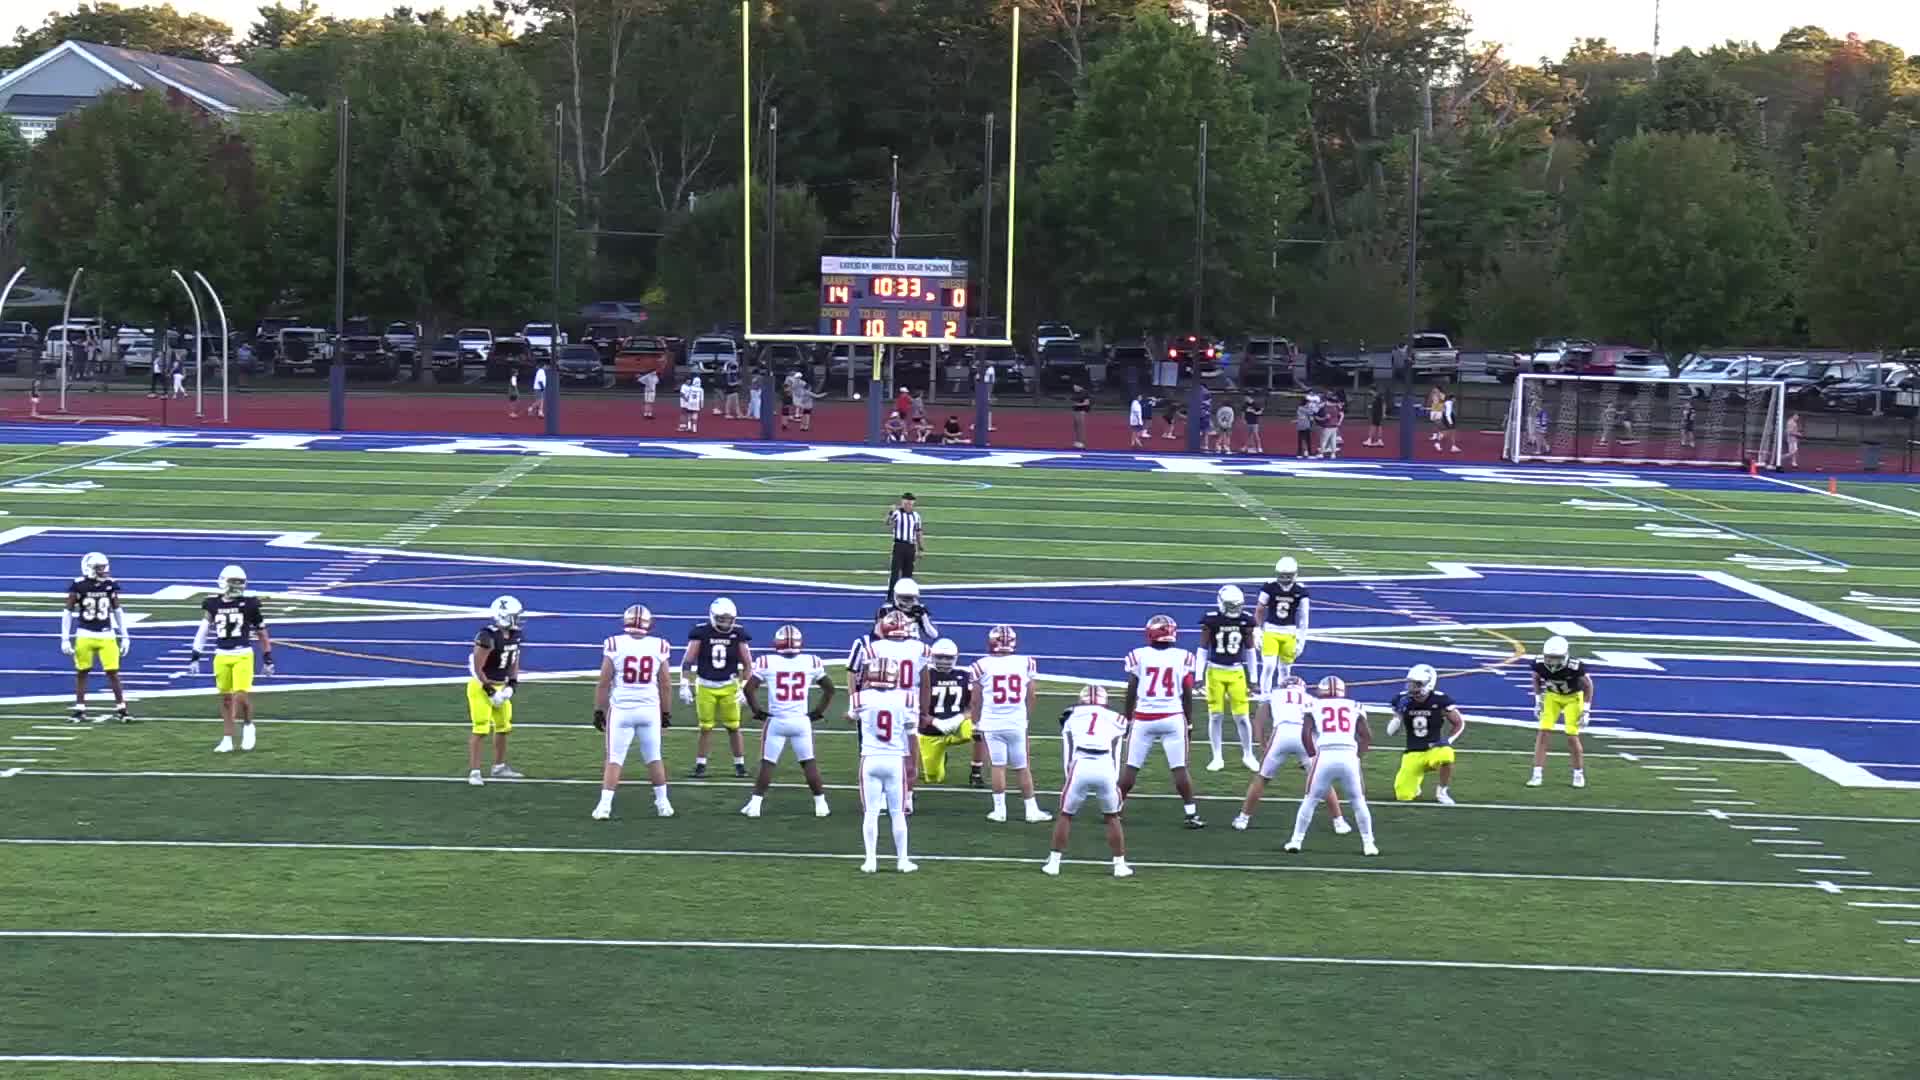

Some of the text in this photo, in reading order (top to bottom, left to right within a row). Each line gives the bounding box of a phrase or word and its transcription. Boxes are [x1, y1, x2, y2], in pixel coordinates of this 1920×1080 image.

[828, 286, 849, 303] 14
[873, 276, 921, 297] 10:33
[953, 289, 966, 308] 0
[835, 319, 842, 336] 1
[866, 319, 885, 337] 10
[902, 319, 927, 338] 29
[945, 321, 957, 339] 2
[82, 597, 110, 621] 39
[1276, 602, 1290, 619] 6
[214, 613, 244, 638] 27
[1215, 631, 1242, 655] 18
[624, 655, 654, 682] 68
[711, 644, 727, 669] 0
[776, 671, 806, 702] 52
[900, 660, 914, 689] 0
[1145, 666, 1176, 697] 74
[931, 686, 963, 713] 77
[993, 674, 1023, 701] 59
[1286, 691, 1303, 705] 11
[877, 710, 892, 742] 9
[1088, 712, 1098, 736] 1
[1322, 706, 1352, 733] 26
